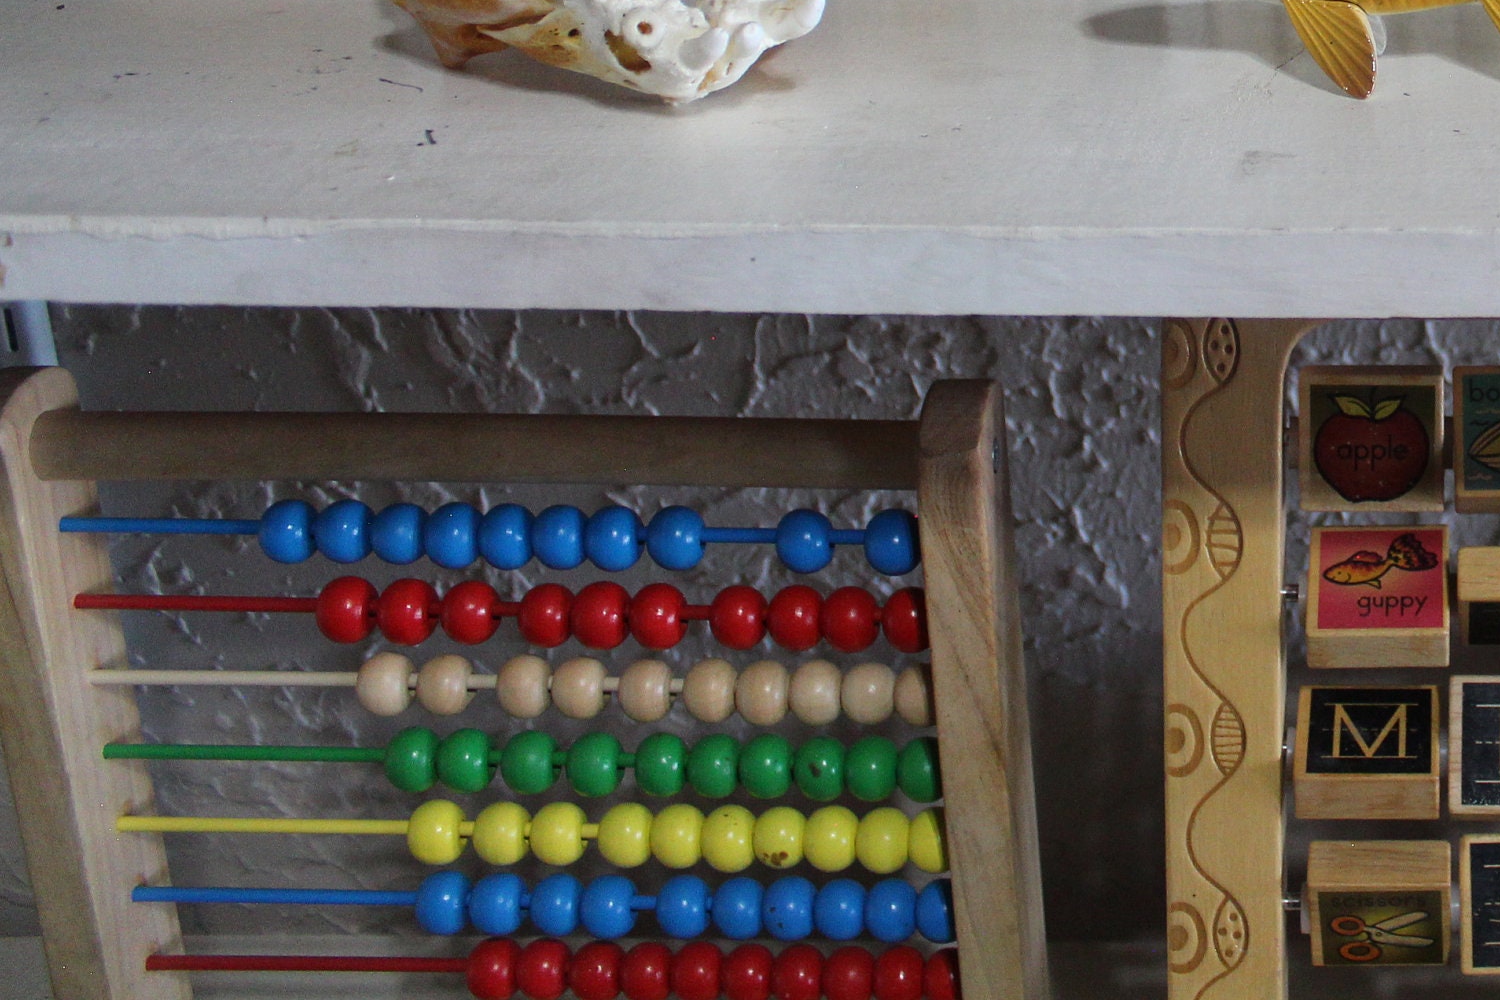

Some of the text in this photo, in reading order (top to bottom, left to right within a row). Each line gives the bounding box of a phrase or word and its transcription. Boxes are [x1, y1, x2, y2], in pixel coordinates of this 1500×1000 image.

[1336, 433, 1409, 471] apple
[1356, 592, 1429, 619] guppy
[1332, 703, 1408, 758] M
